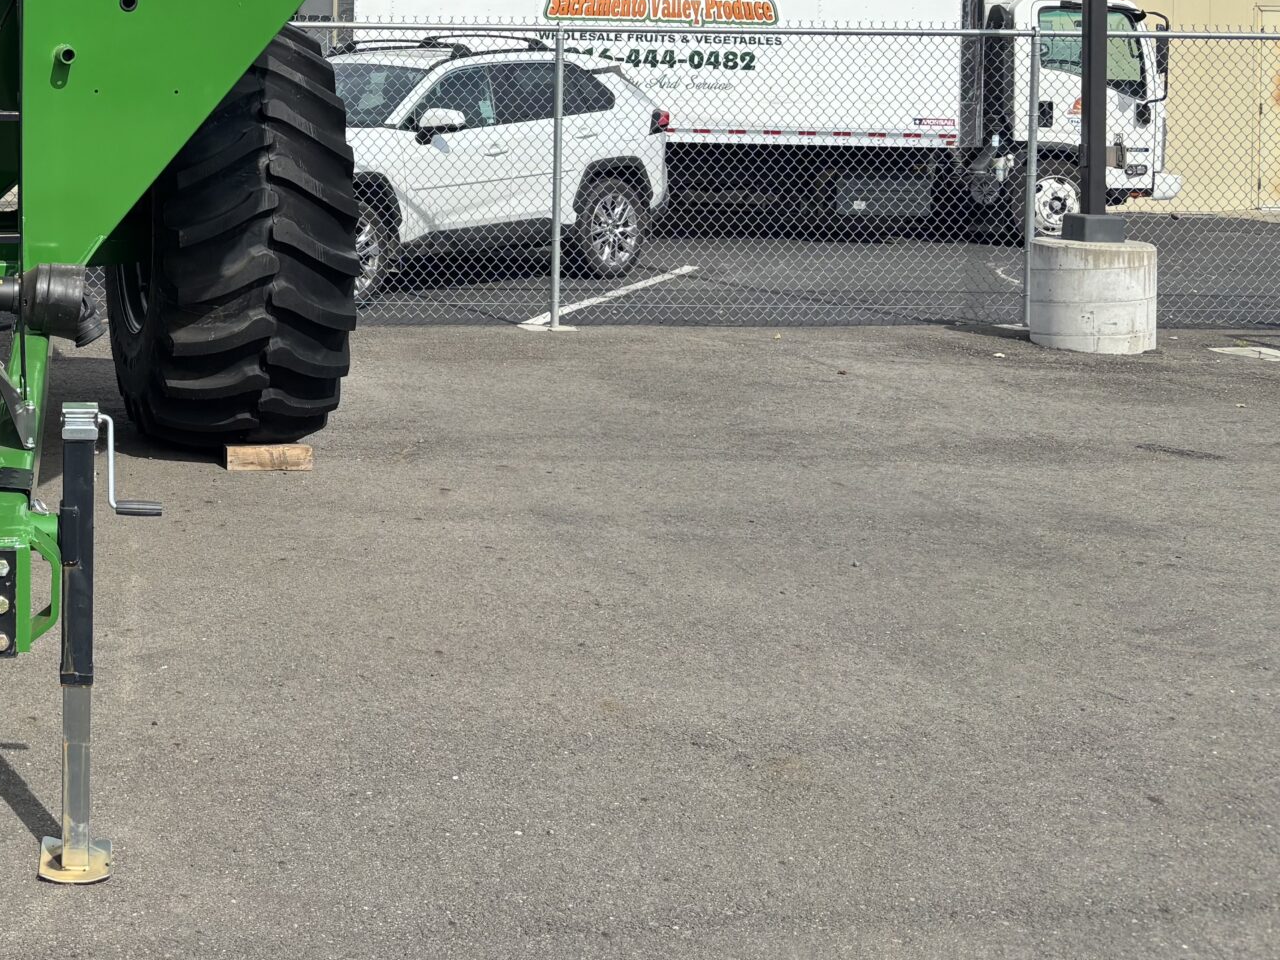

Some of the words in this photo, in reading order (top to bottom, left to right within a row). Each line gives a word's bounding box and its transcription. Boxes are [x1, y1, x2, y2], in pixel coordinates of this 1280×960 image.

[539, 31, 622, 42] WHOLESALE
[627, 33, 676, 44] FRUITS
[681, 34, 690, 44] &
[695, 35, 782, 46] VEGETABLES
